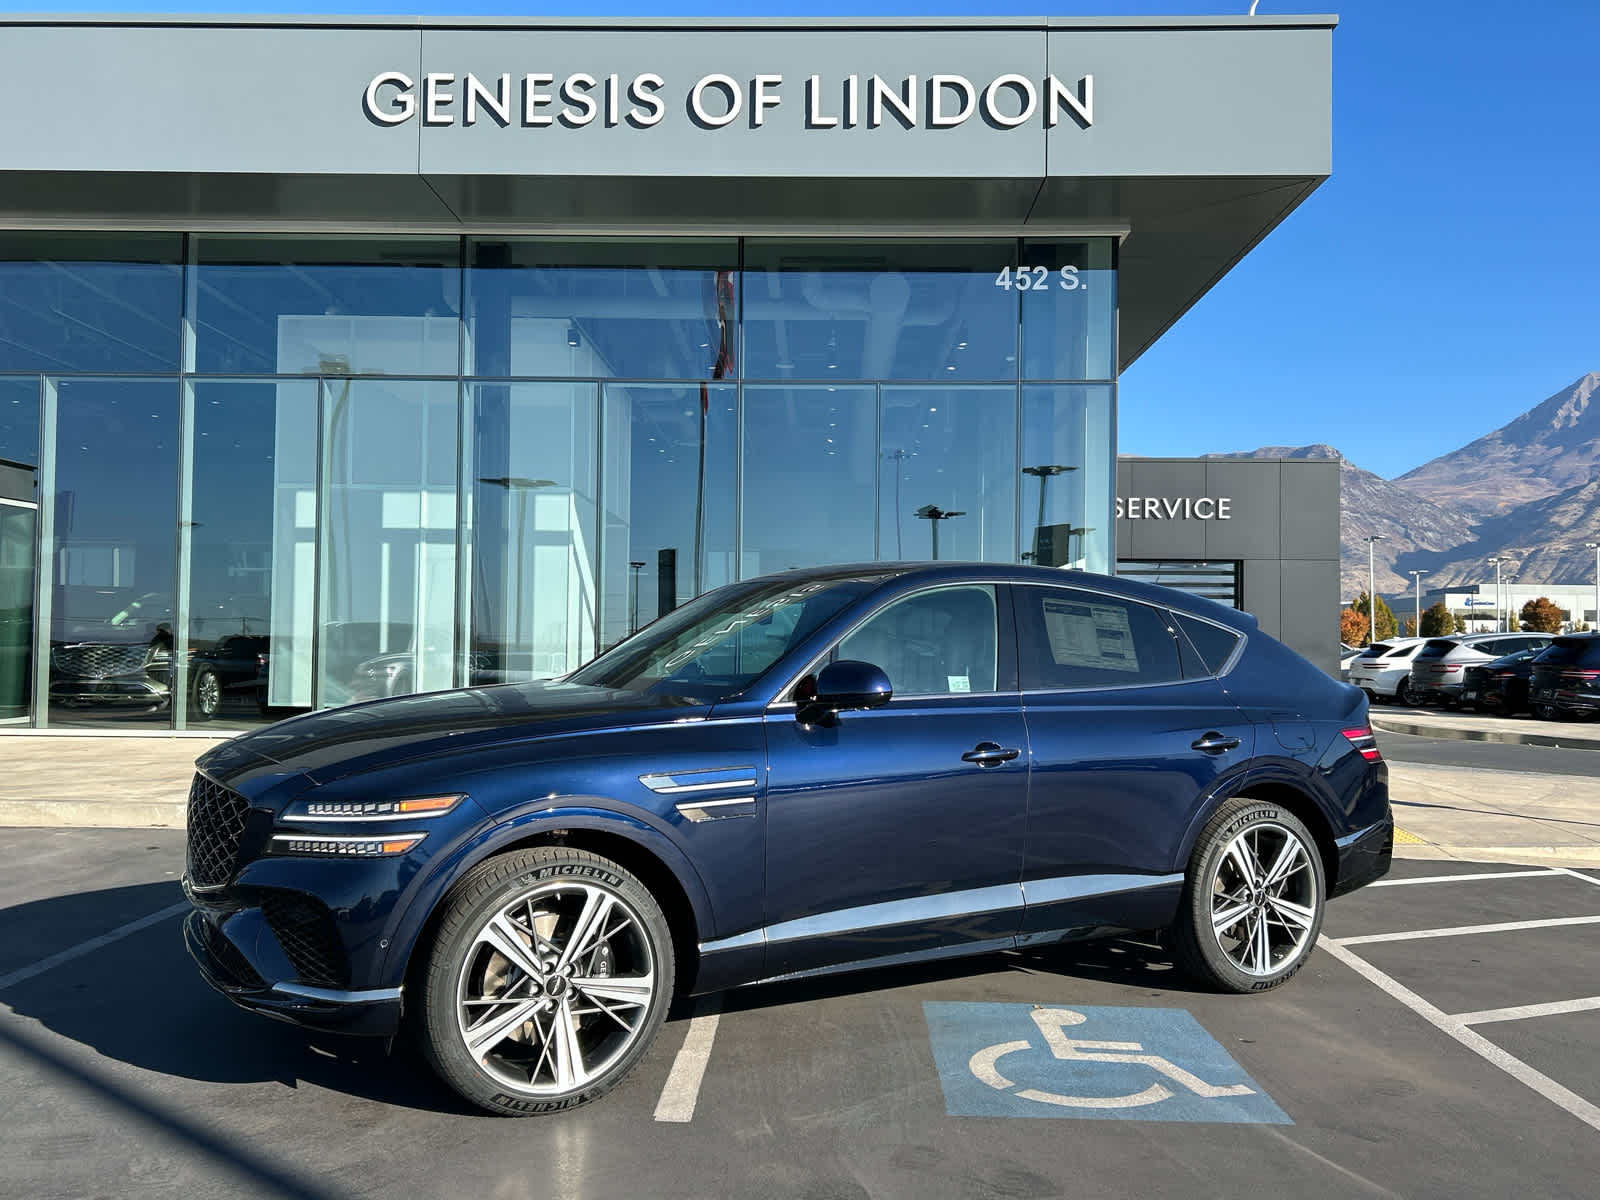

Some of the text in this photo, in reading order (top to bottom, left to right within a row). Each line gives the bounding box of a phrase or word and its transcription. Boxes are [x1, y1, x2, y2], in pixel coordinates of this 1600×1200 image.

[364, 71, 1094, 128] GENESIS OF LINDON
[995, 265, 1087, 291] 452 S.
[1231, 810, 1277, 832] MICHELIN
[539, 864, 620, 886] MICHELIN
